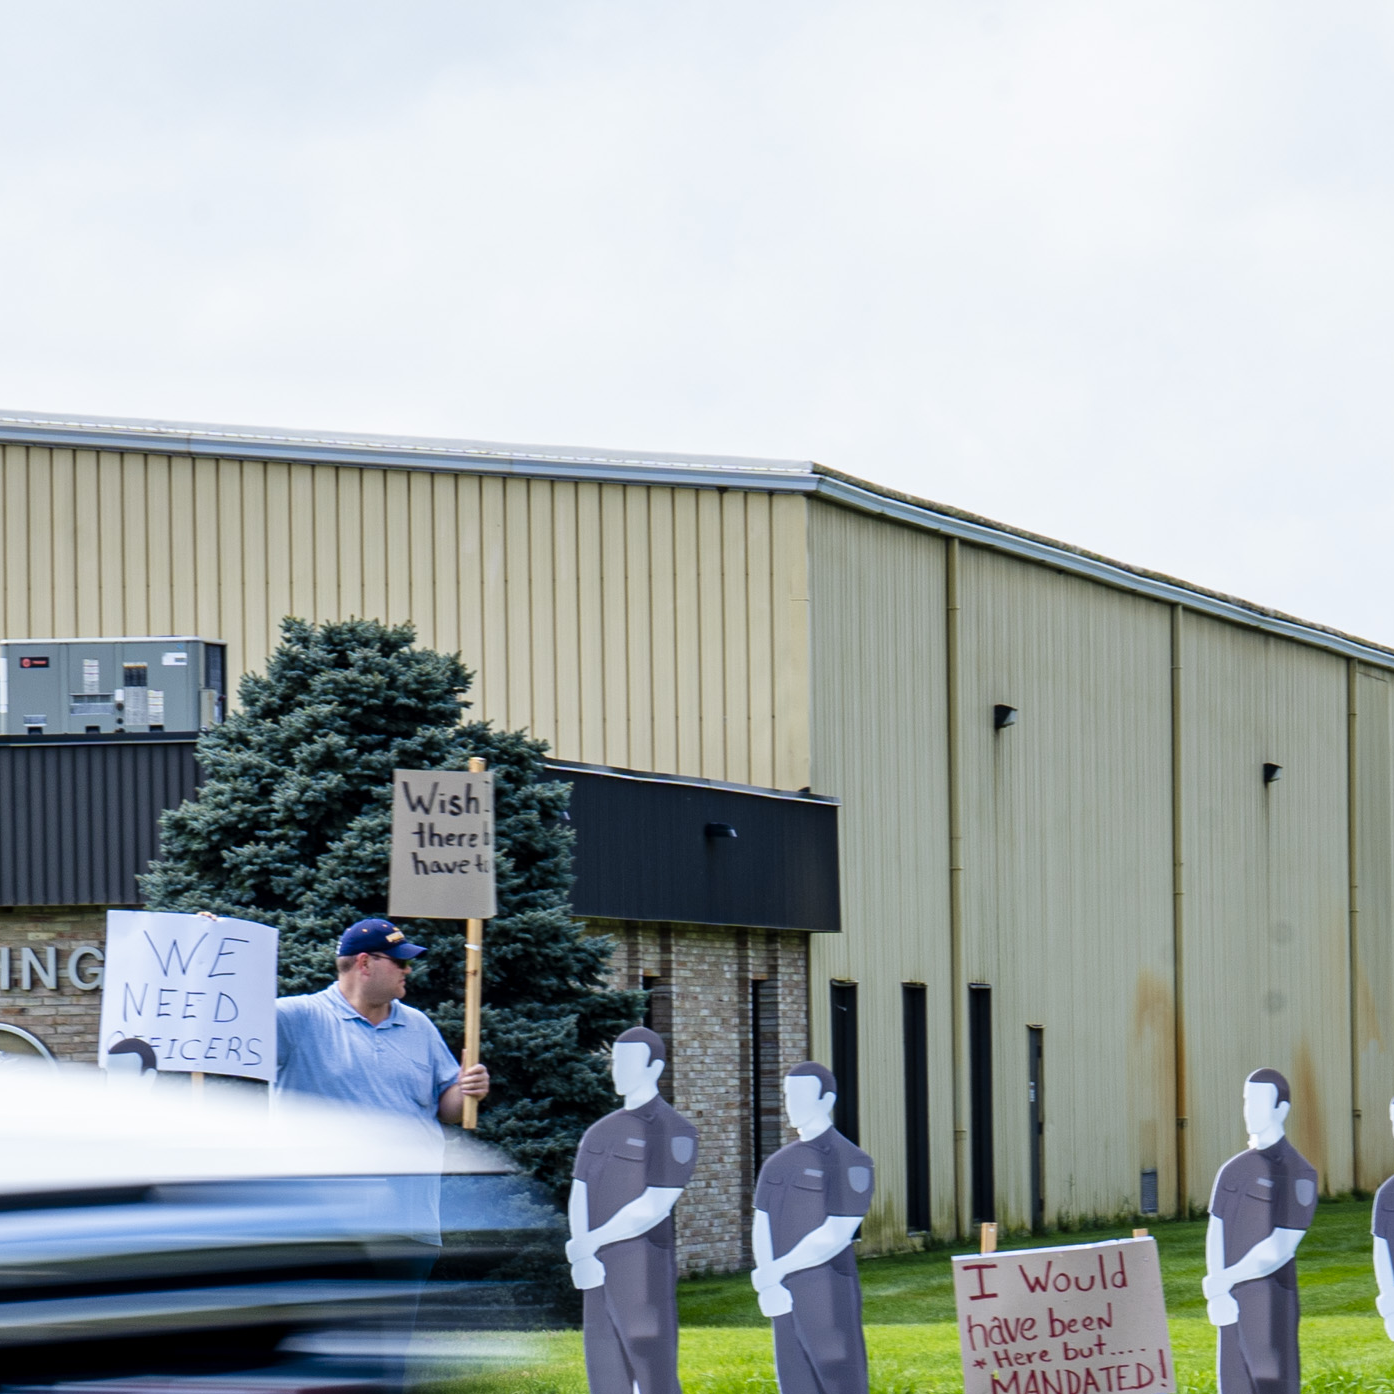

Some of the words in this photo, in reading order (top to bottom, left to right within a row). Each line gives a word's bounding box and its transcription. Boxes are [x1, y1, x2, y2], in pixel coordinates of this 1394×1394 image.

[402, 781, 480, 816] Wish
[411, 822, 478, 848] there
[411, 852, 470, 875] have
[144, 930, 250, 978] WE
[123, 982, 239, 1023] NEED
[108, 1030, 263, 1066] FICERS
[962, 1263, 999, 1301] I
[1018, 1251, 1128, 1293] Would
[967, 1314, 1038, 1351] have
[993, 1349, 1053, 1369] Here
